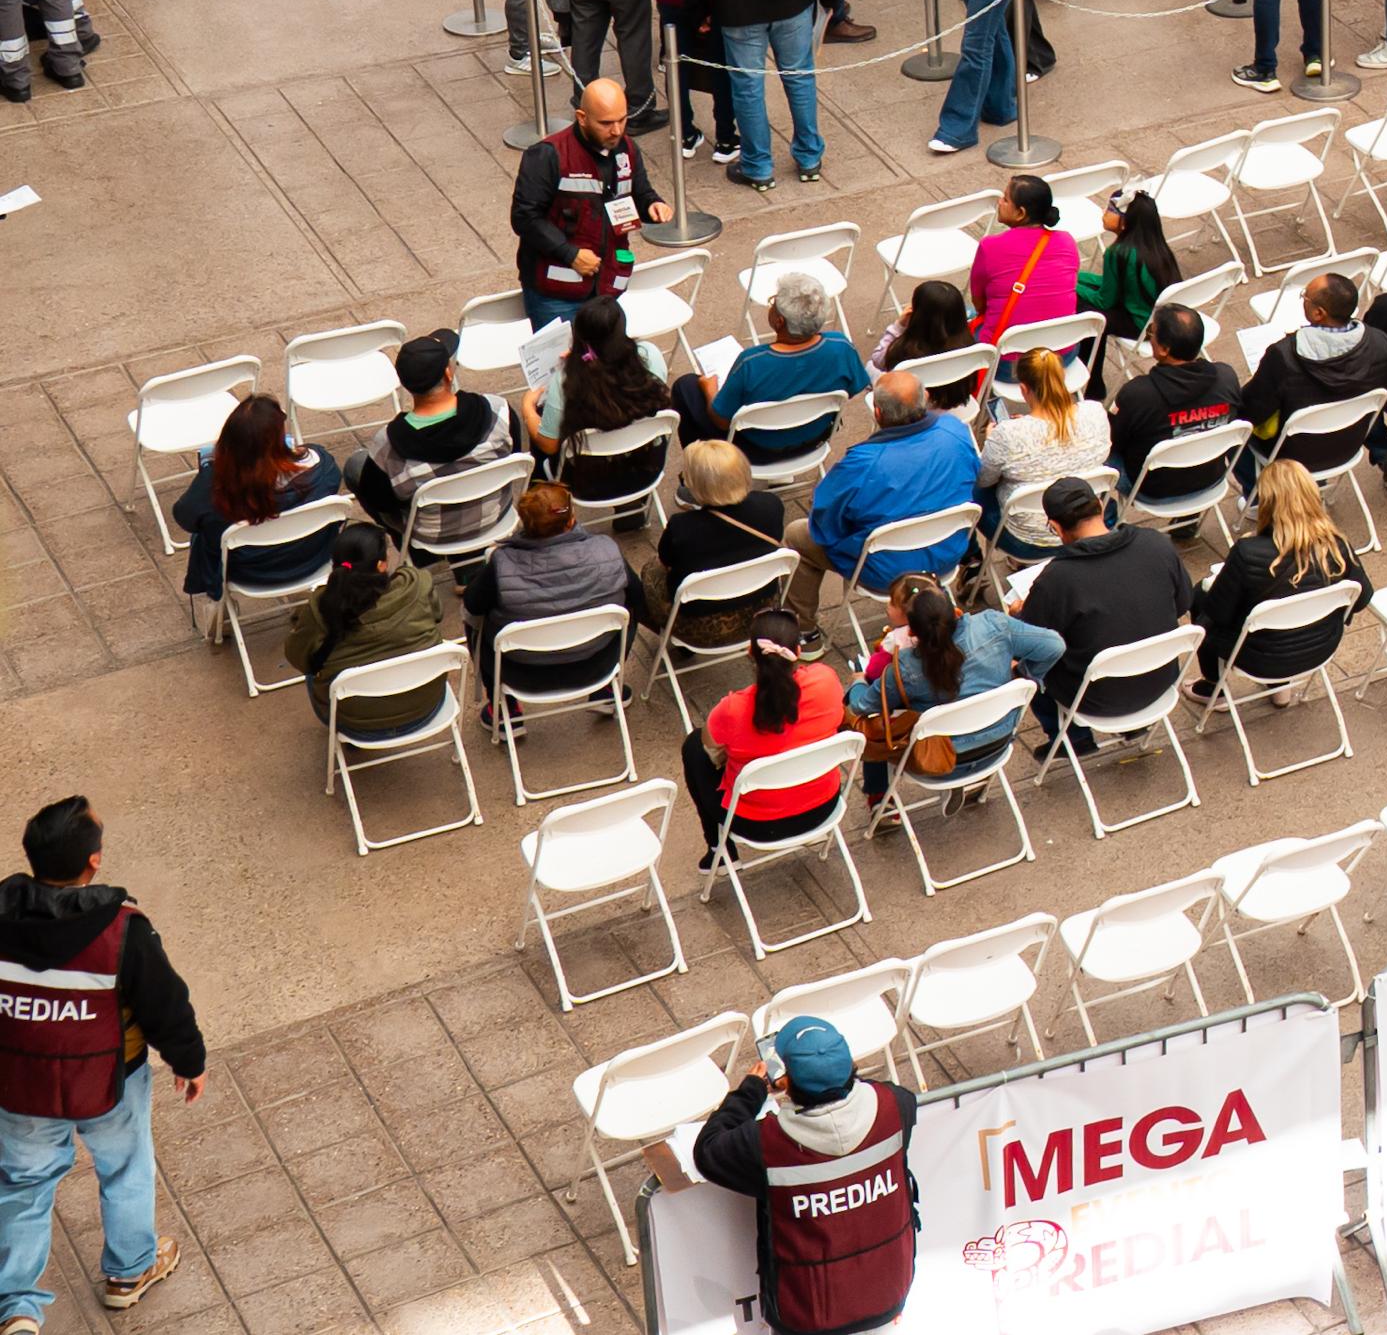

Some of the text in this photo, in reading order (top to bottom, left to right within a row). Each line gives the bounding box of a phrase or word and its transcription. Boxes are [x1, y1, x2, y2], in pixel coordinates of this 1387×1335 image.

[0, 995, 96, 1022] REDIAL
[1003, 1088, 1266, 1209] MEGA
[792, 1168, 899, 1219] PREDIAL
